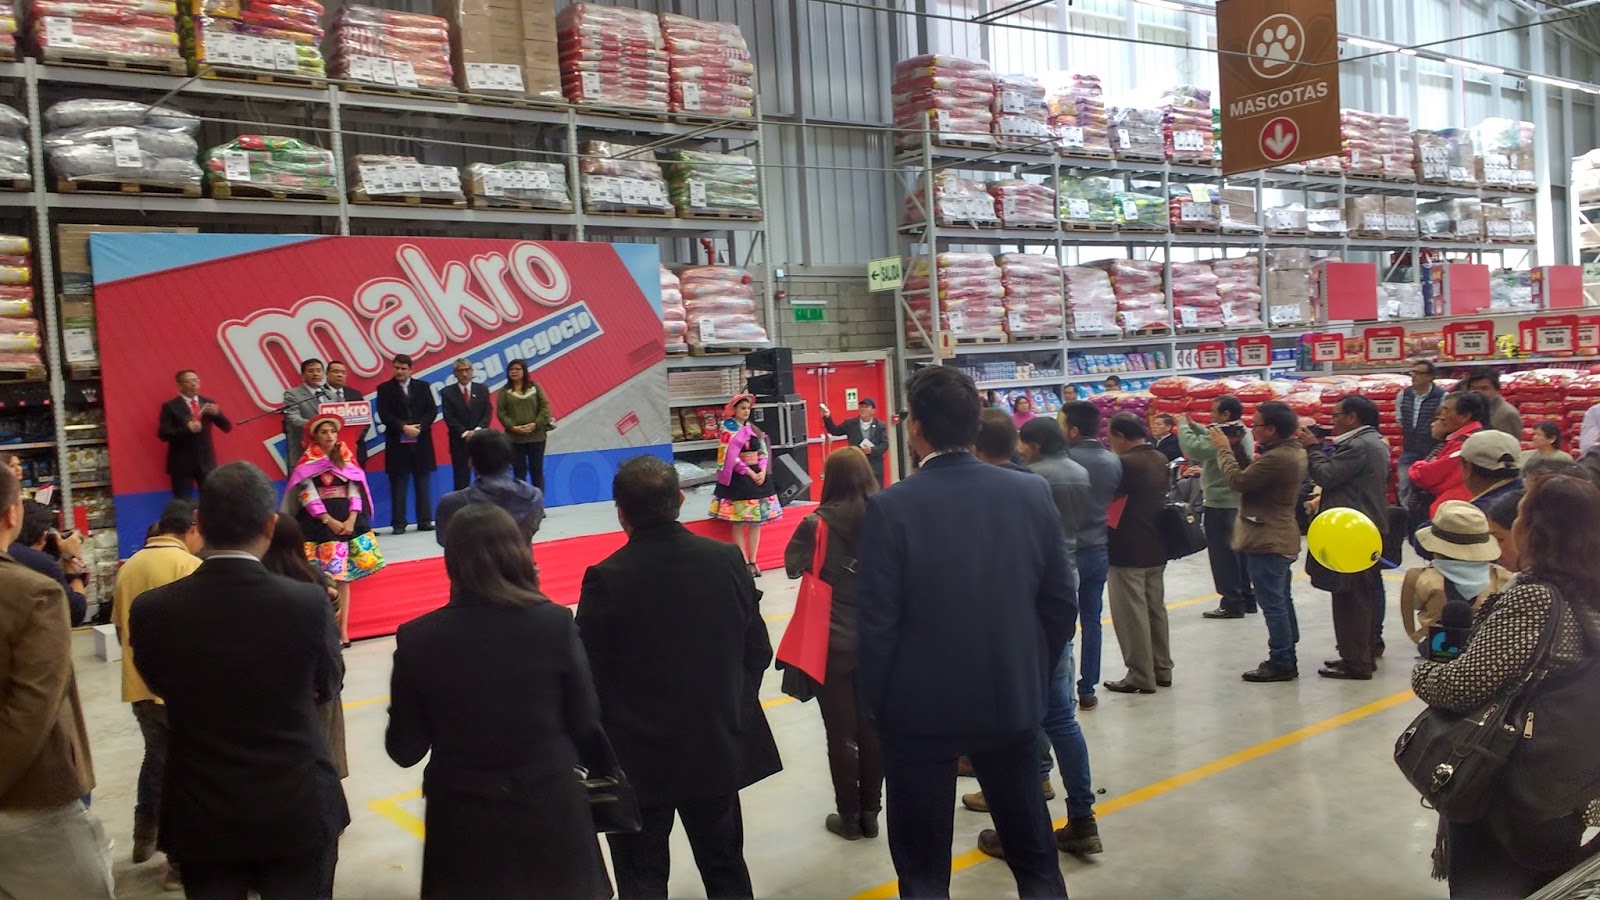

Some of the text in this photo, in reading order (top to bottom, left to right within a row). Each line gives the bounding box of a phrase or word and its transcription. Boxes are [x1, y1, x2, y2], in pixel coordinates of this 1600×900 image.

[1229, 82, 1328, 118] MASCOTAS
[881, 264, 900, 282] SALIDA
[218, 241, 572, 412] makro
[472, 311, 592, 384] su negocio
[321, 402, 370, 418] makro
